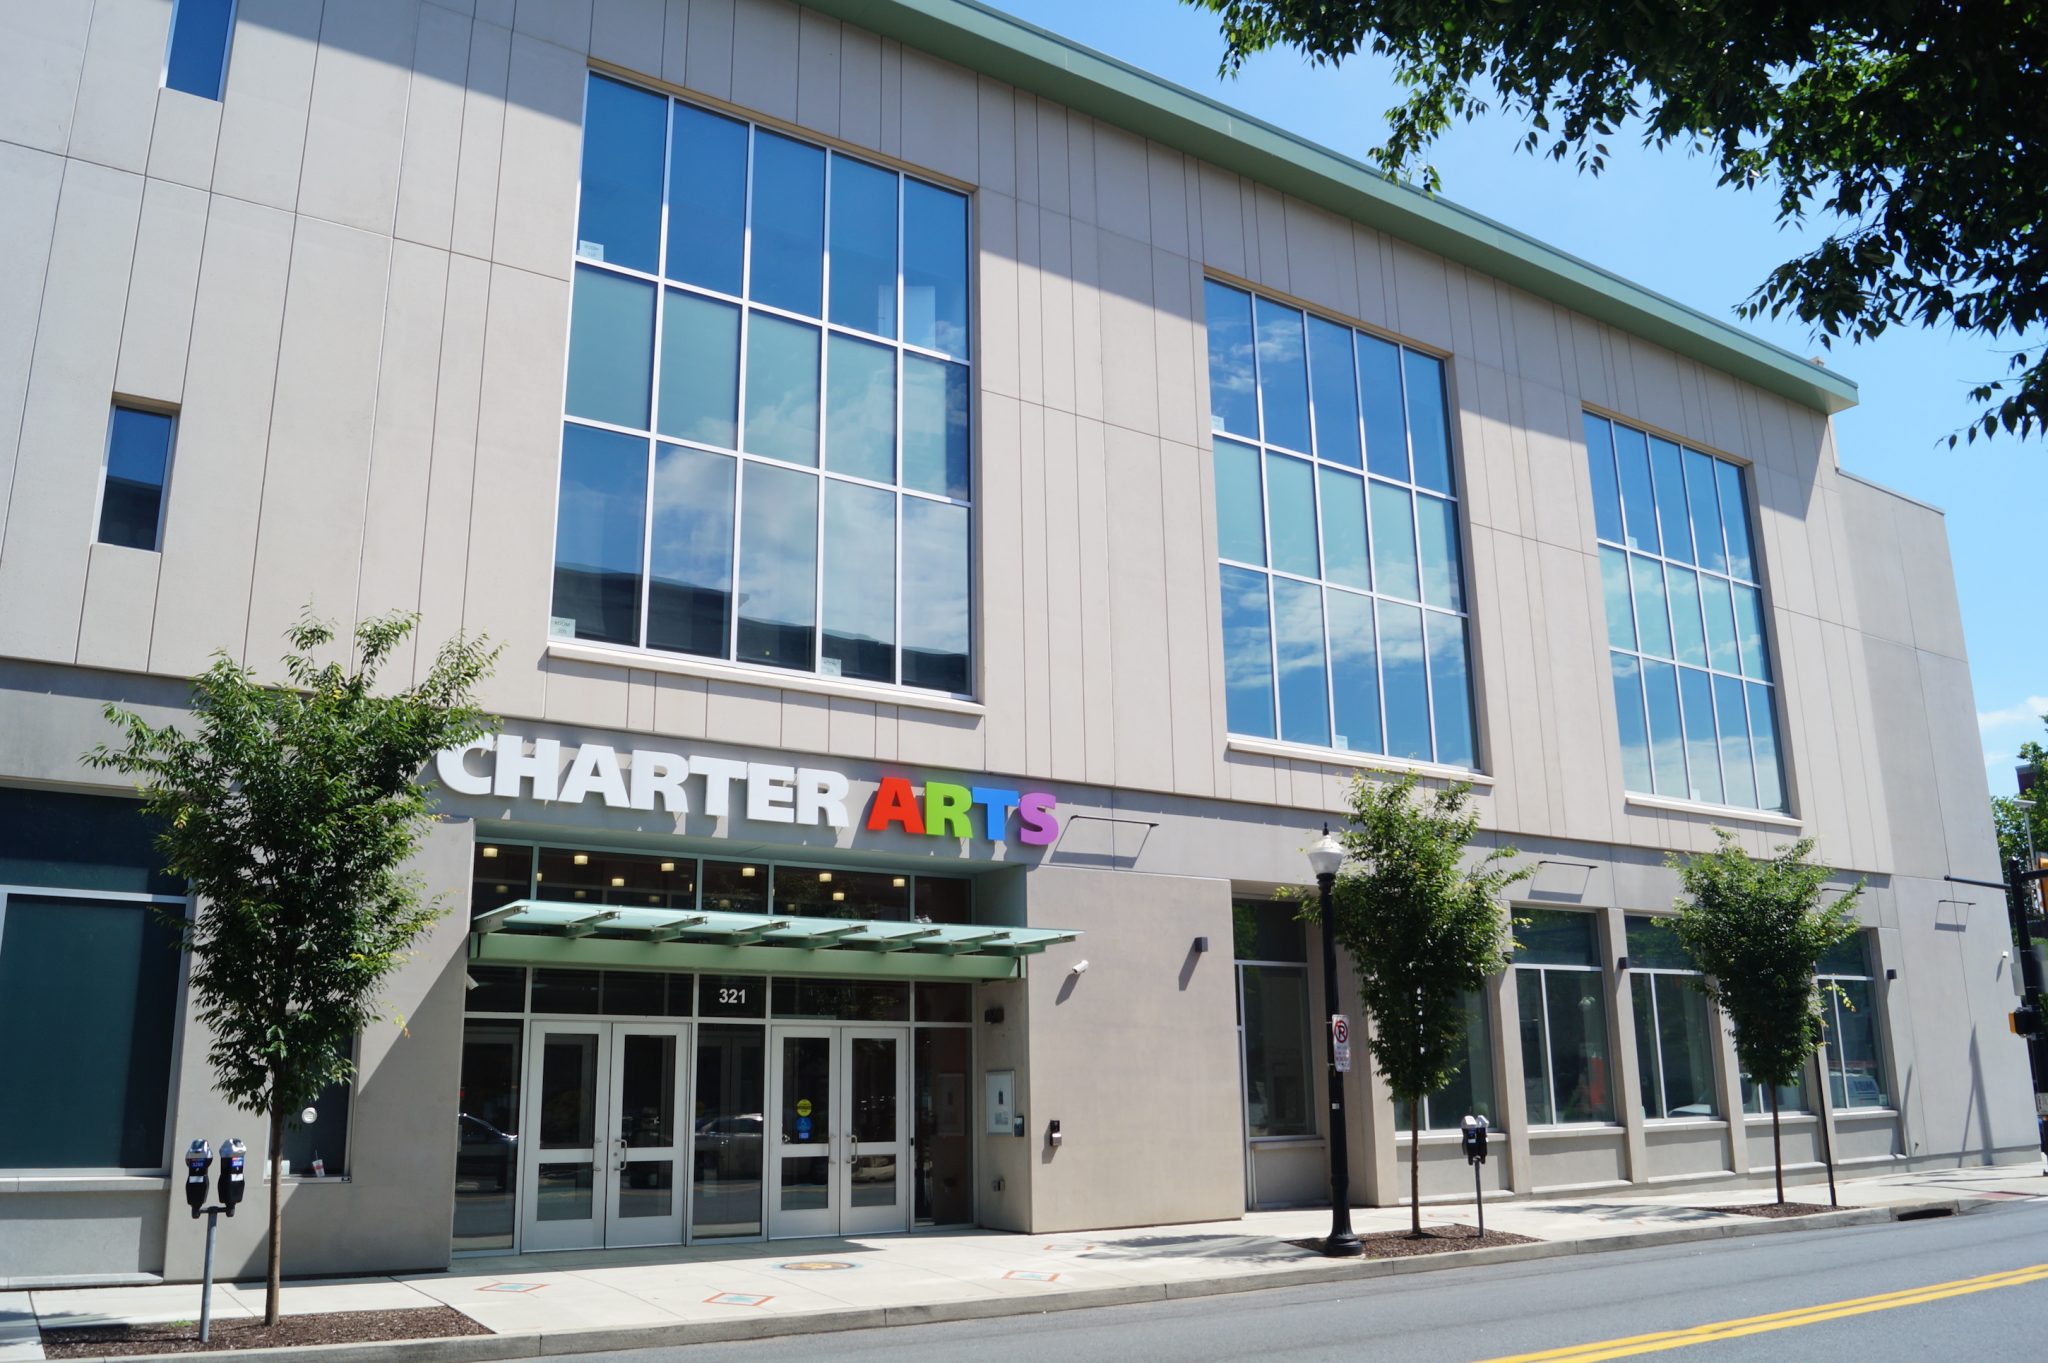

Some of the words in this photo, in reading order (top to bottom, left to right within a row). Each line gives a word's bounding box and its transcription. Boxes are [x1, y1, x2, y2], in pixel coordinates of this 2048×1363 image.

[437, 732, 849, 828] CHARTER
[866, 776, 1059, 846] ARTS
[718, 988, 746, 1004] 321
